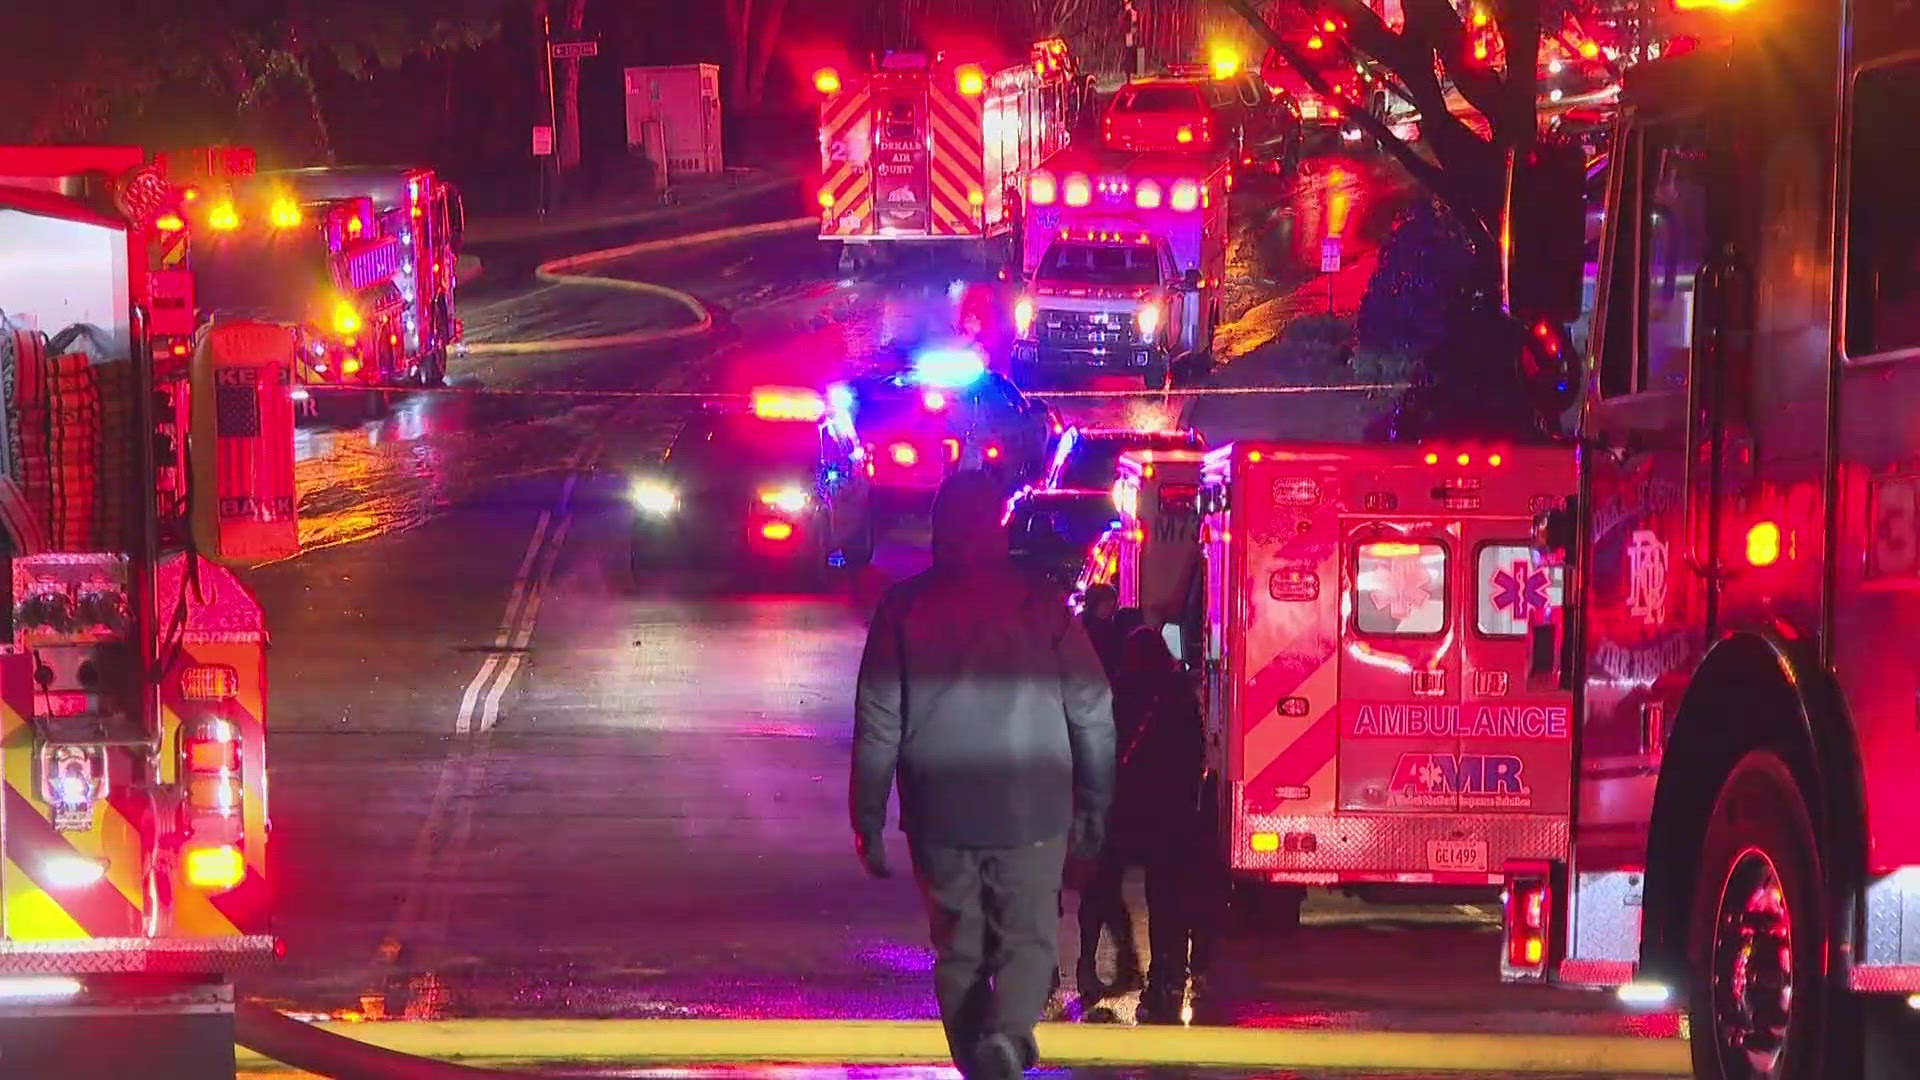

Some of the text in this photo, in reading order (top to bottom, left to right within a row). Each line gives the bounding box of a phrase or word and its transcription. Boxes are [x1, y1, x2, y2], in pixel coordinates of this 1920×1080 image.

[892, 153, 911, 162] AIR
[1354, 705, 1567, 738] AMBULANCE
[1388, 752, 1524, 795] AMR
